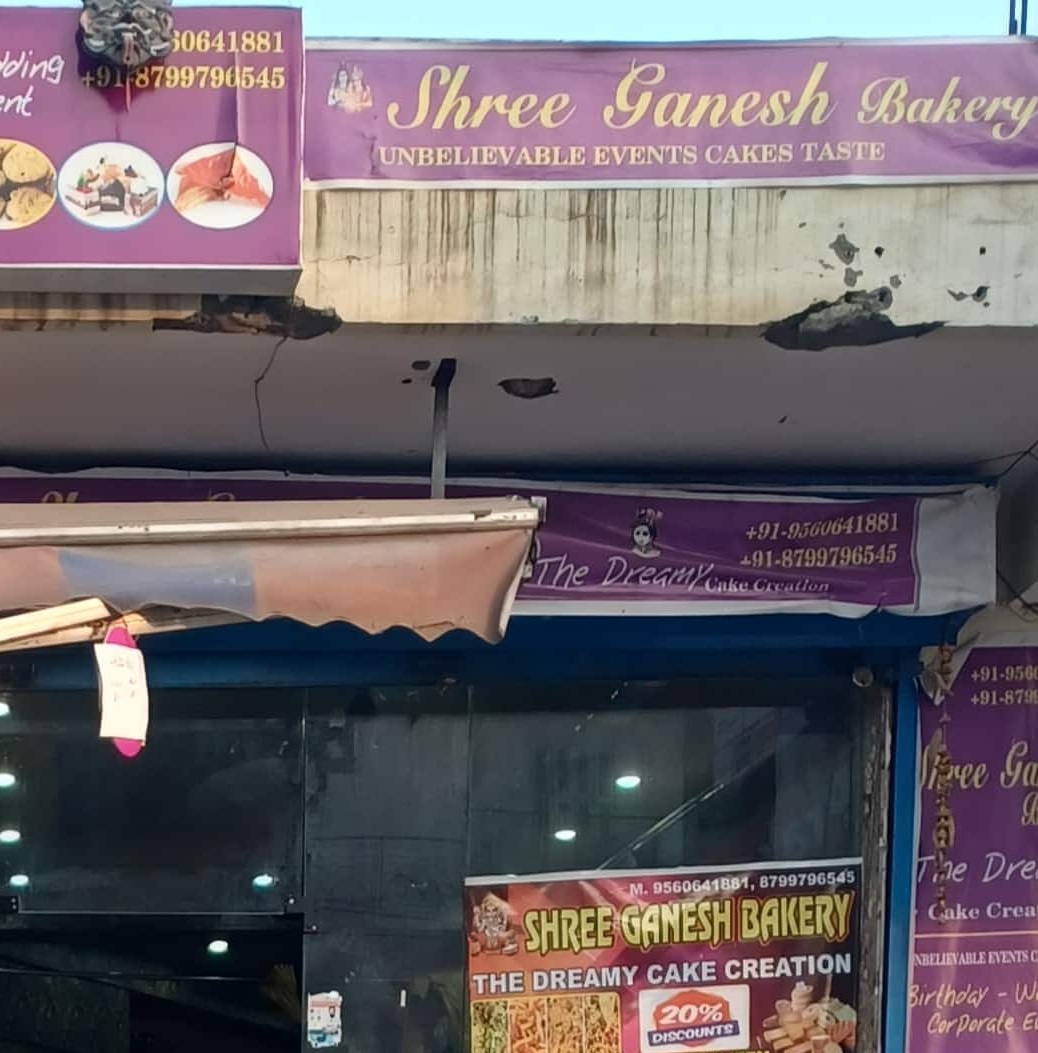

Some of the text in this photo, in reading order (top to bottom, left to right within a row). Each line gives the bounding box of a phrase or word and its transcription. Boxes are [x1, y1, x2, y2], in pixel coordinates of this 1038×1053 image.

[386, 60, 1038, 140] Shree Ganesh Bakery
[378, 141, 886, 168] UNBELIEVABLE EVENTS CAKES TASTE
[536, 556, 830, 593] The Dreamy Cake Creation
[630, 882, 649, 896] M.
[986, 901, 1038, 919] Crea
[523, 891, 855, 955] SHREE GANESH BAKERY
[988, 950, 1029, 965] EVENTS
[473, 953, 852, 994] THE DREAMY CAKE CREATION
[908, 983, 990, 1008] Birthday
[659, 1003, 723, 1024] 20%
[651, 1023, 735, 1043] DISCOUNTS
